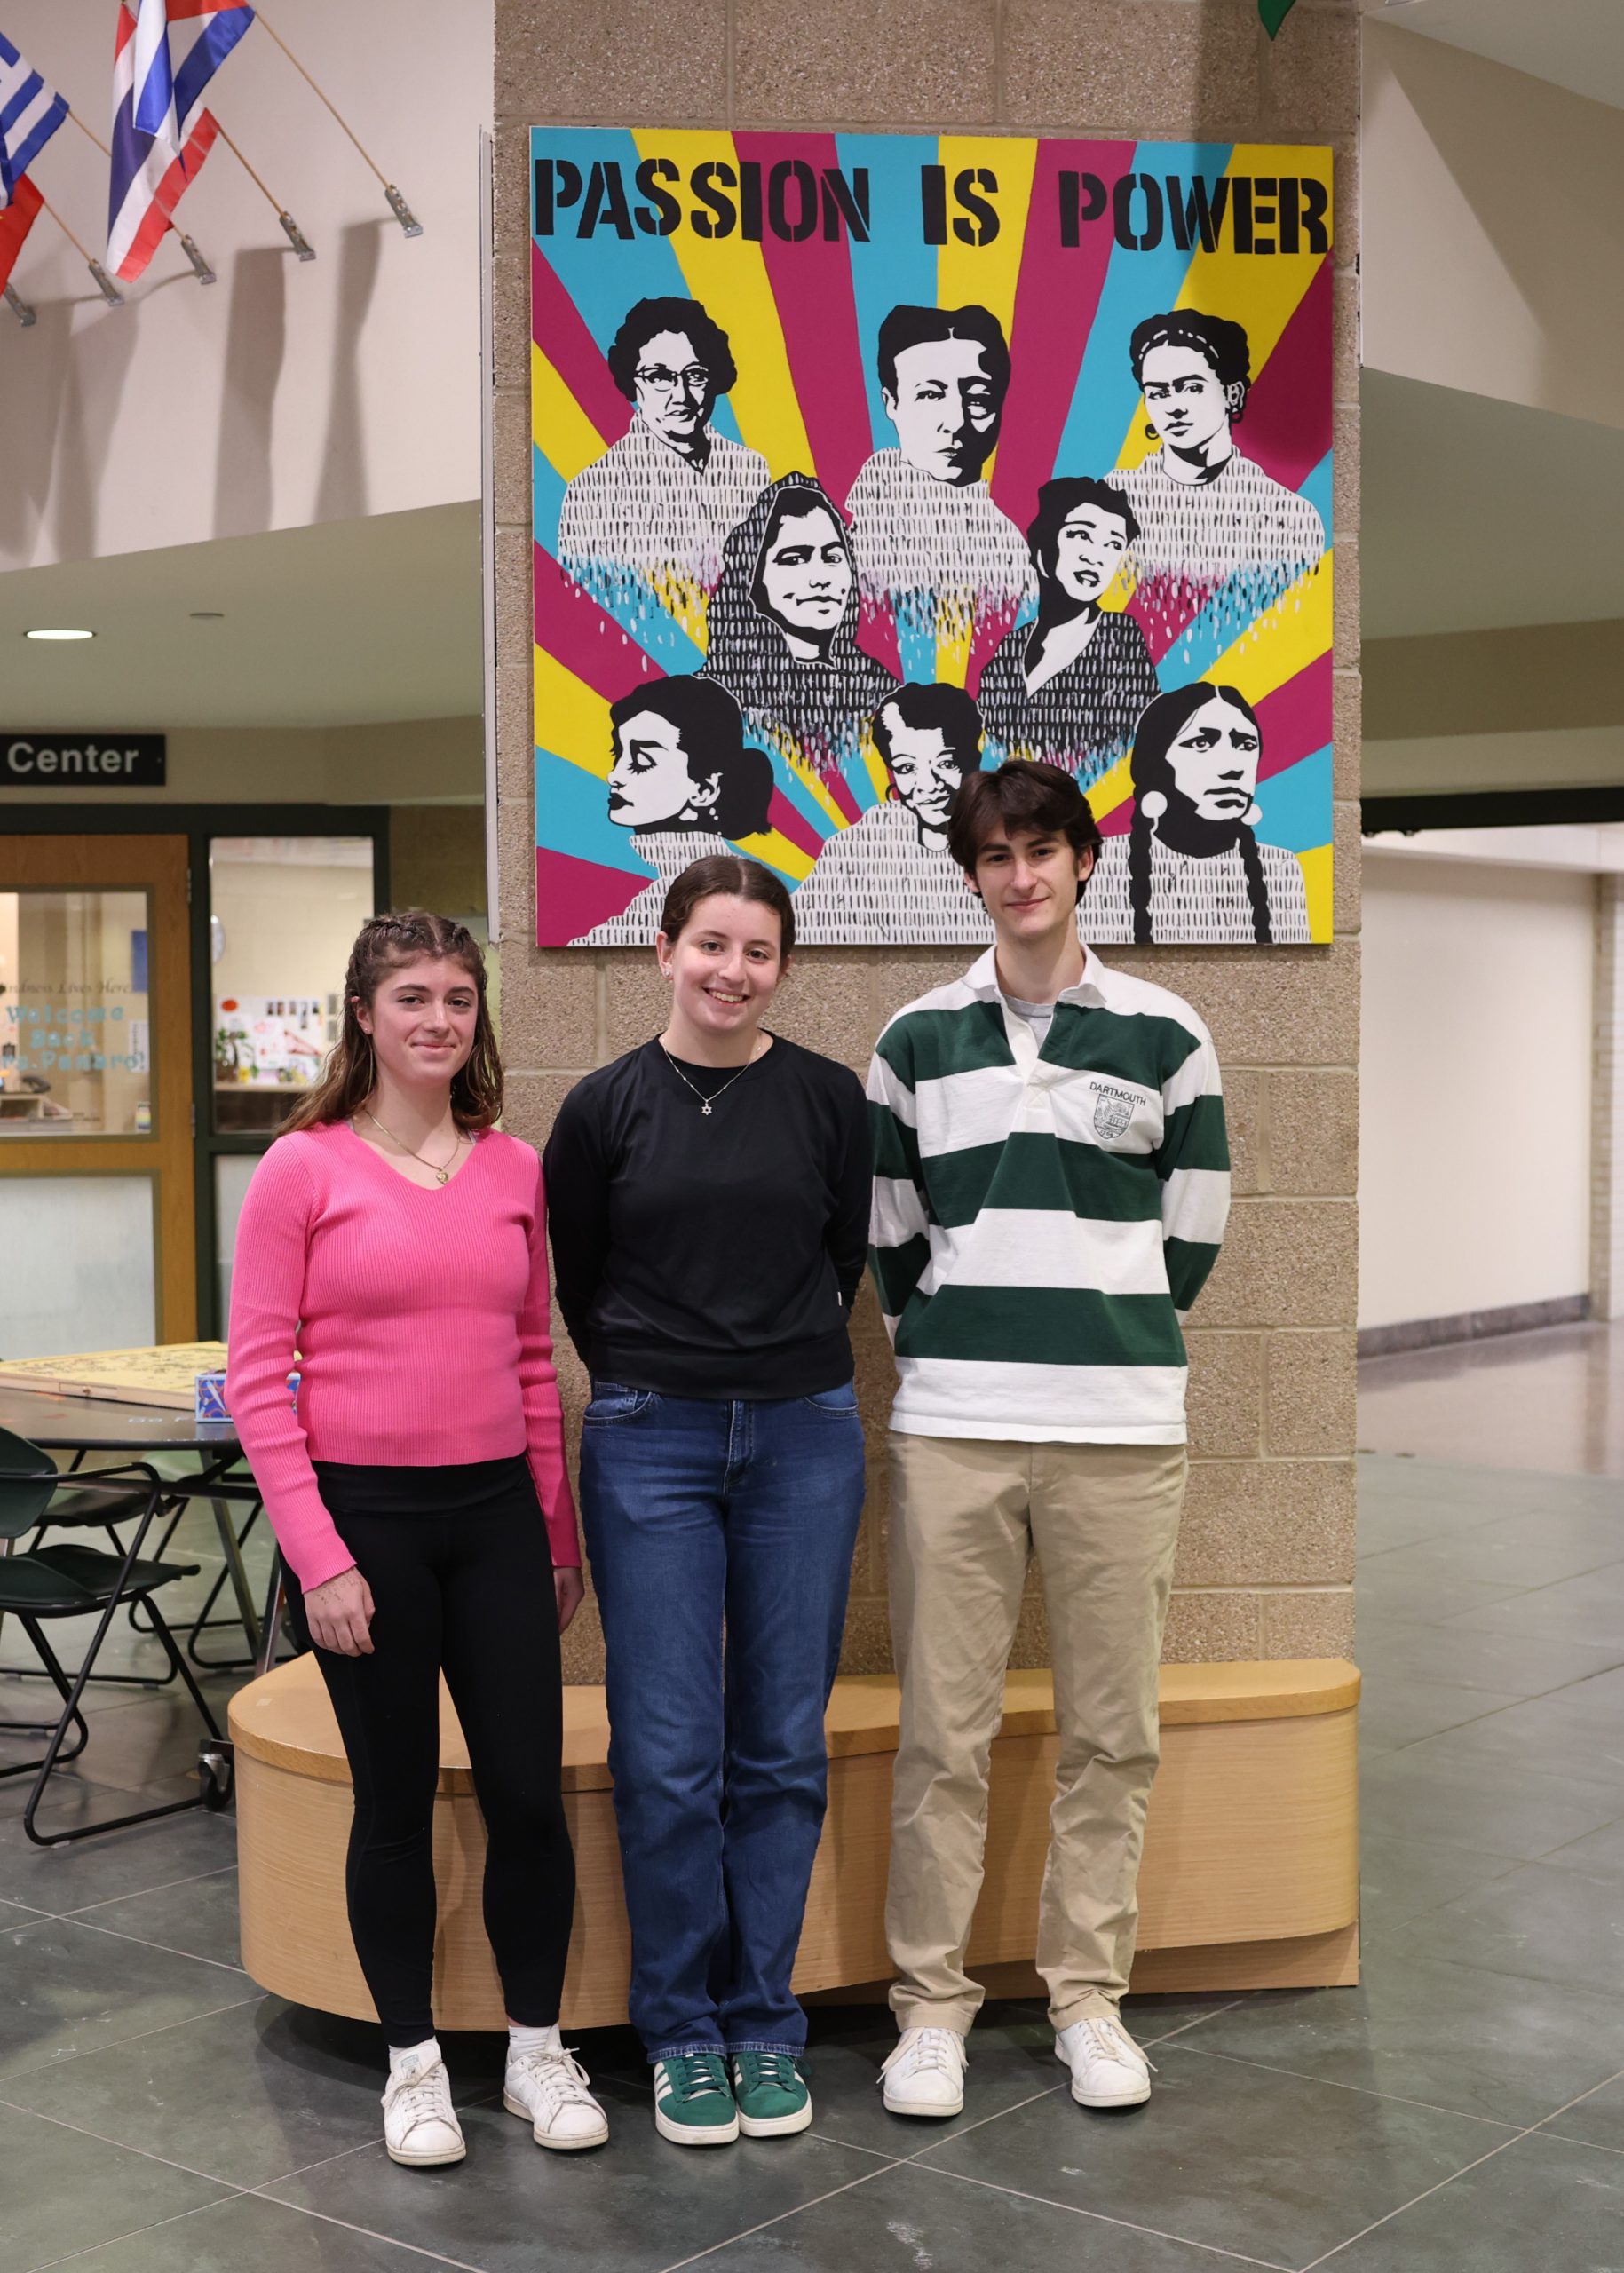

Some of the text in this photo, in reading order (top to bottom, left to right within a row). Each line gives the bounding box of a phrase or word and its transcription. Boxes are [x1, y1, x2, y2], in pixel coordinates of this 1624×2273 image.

[535, 158, 1328, 254] PASSION IS POWER
[7, 741, 139, 773] Center
[6, 1003, 124, 1023] Welcome
[30, 1027, 96, 1049] Back
[1089, 1081, 1146, 1106] DARTMOUTH
